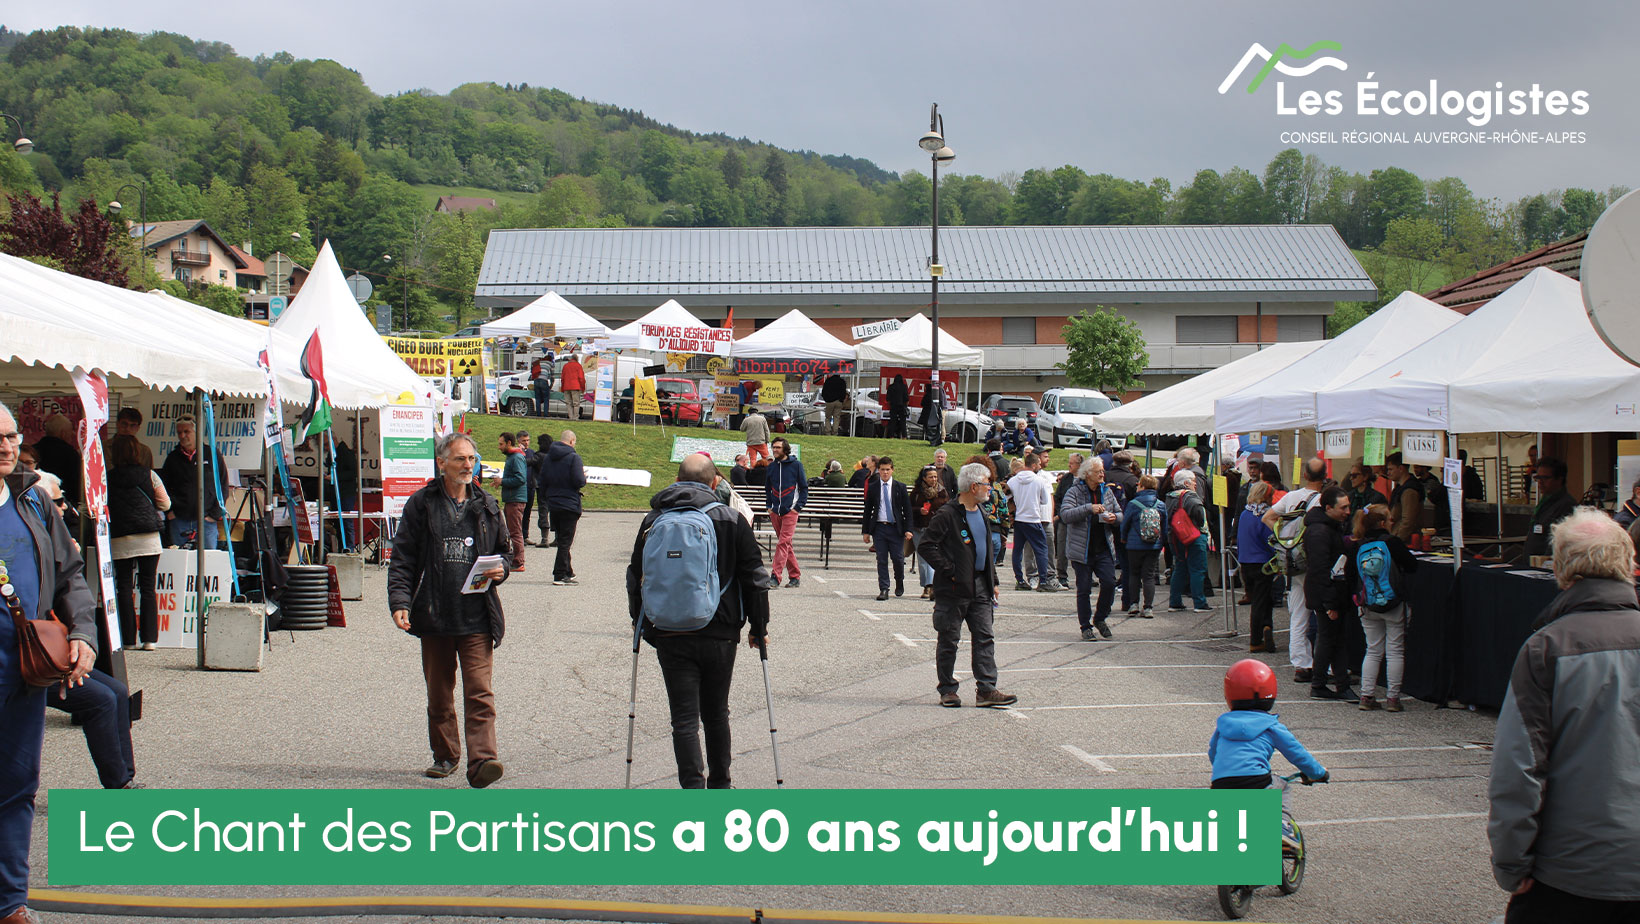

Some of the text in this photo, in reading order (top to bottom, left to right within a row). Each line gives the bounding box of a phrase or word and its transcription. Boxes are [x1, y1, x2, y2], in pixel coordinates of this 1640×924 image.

[641, 324, 665, 337] FORUM
[667, 326, 682, 338] DES
[418, 341, 444, 356] BURE
[404, 357, 446, 375] MAIS
[736, 359, 854, 374] librinfo74.fr
[220, 402, 256, 419] ARENA
[392, 408, 424, 420] ÉMANCIPER
[205, 421, 257, 437] ILLIONS
[1328, 434, 1349, 447] CAISSE
[1407, 438, 1437, 452] CAISSE
